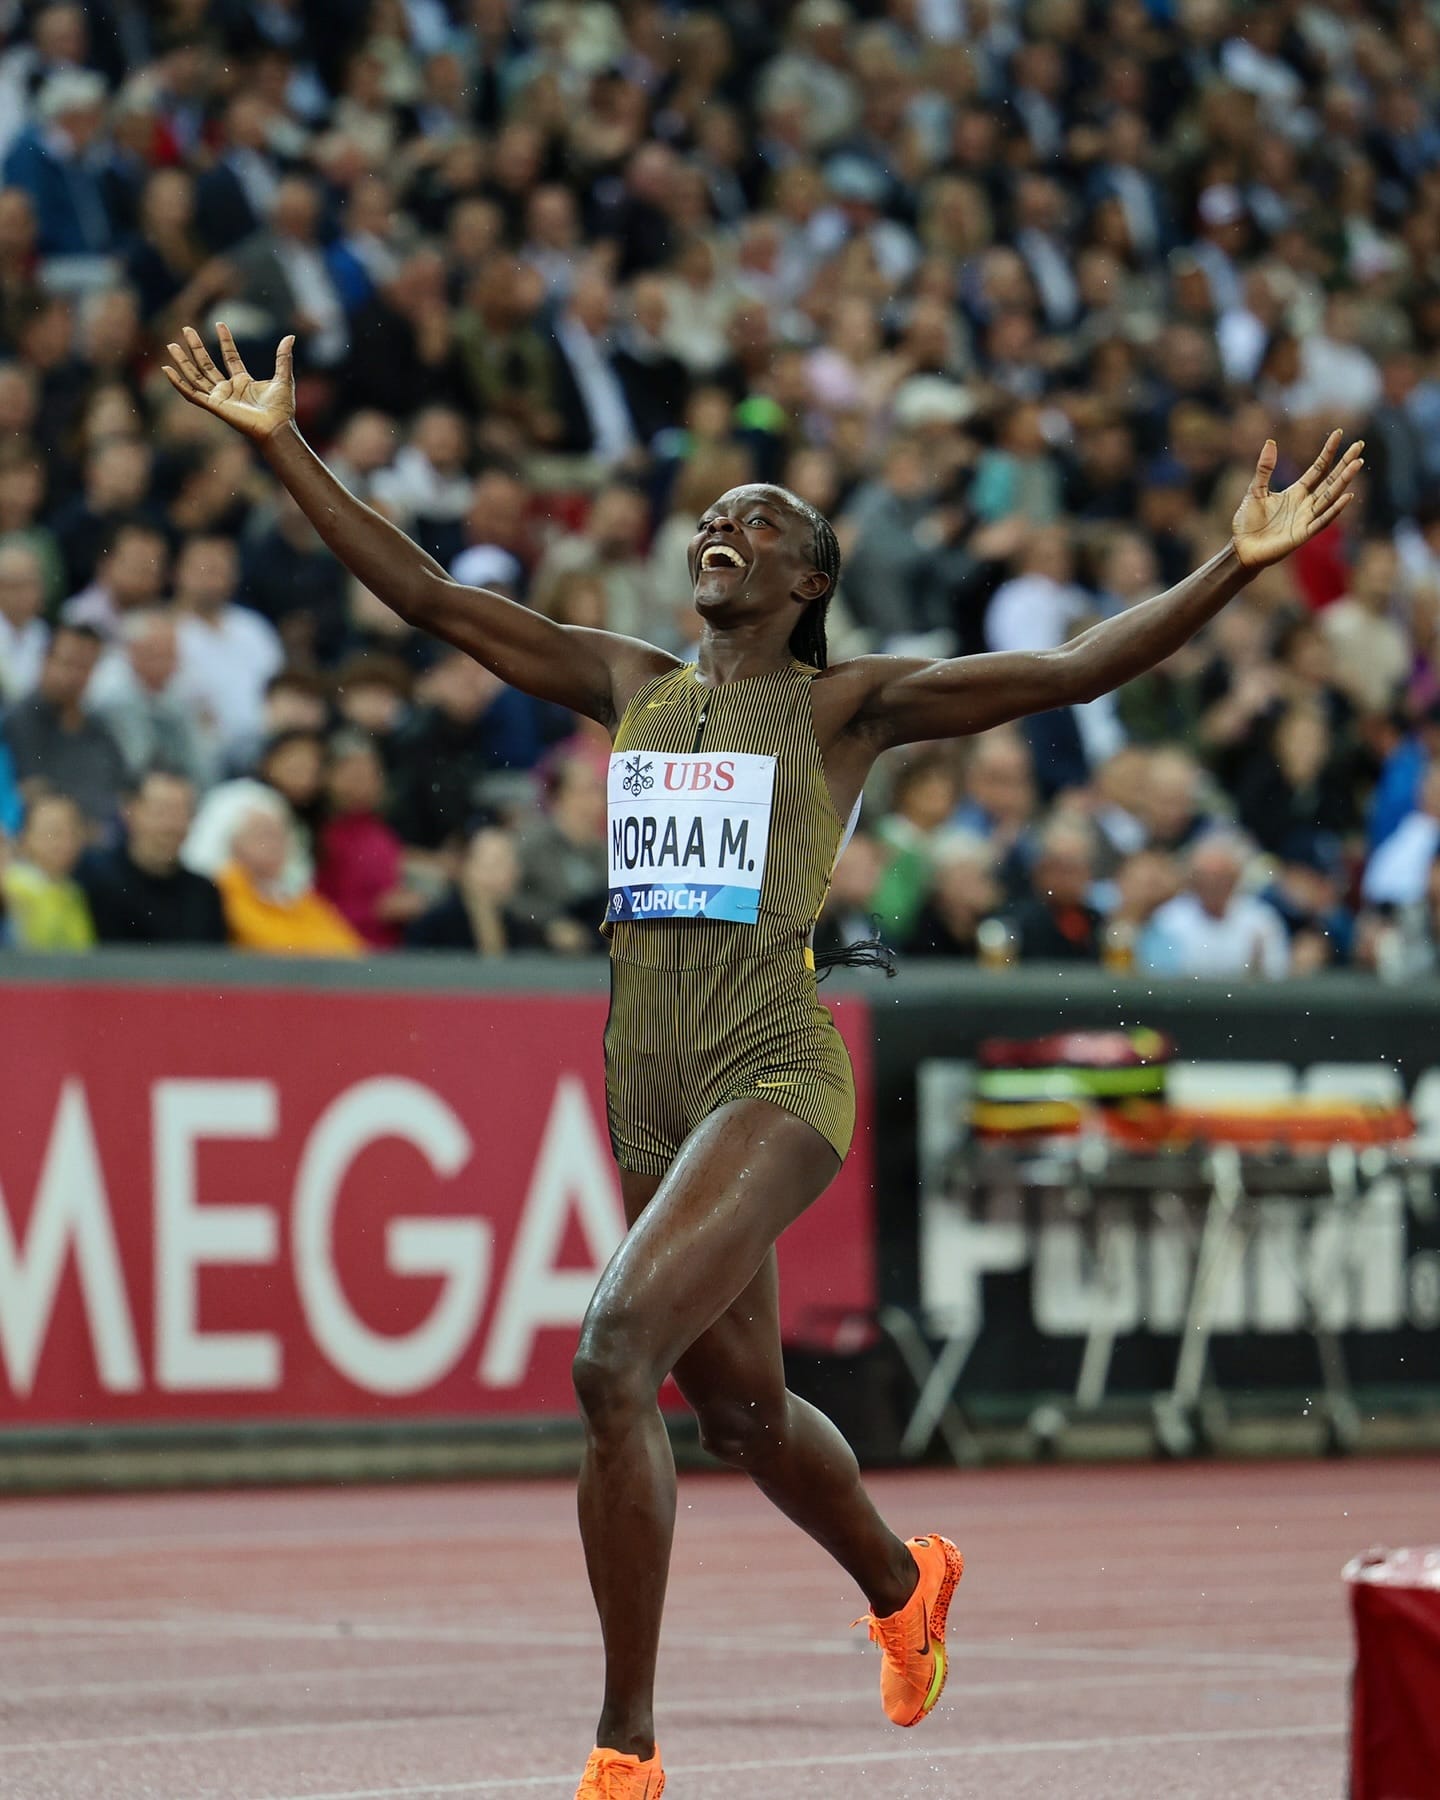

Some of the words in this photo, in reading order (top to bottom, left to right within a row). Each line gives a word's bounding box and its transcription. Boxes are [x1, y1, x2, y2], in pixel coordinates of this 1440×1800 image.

[663, 761, 735, 791] UBS
[612, 815, 706, 872] MORAA
[718, 818, 755, 872] M.
[631, 889, 708, 913] ZURICH
